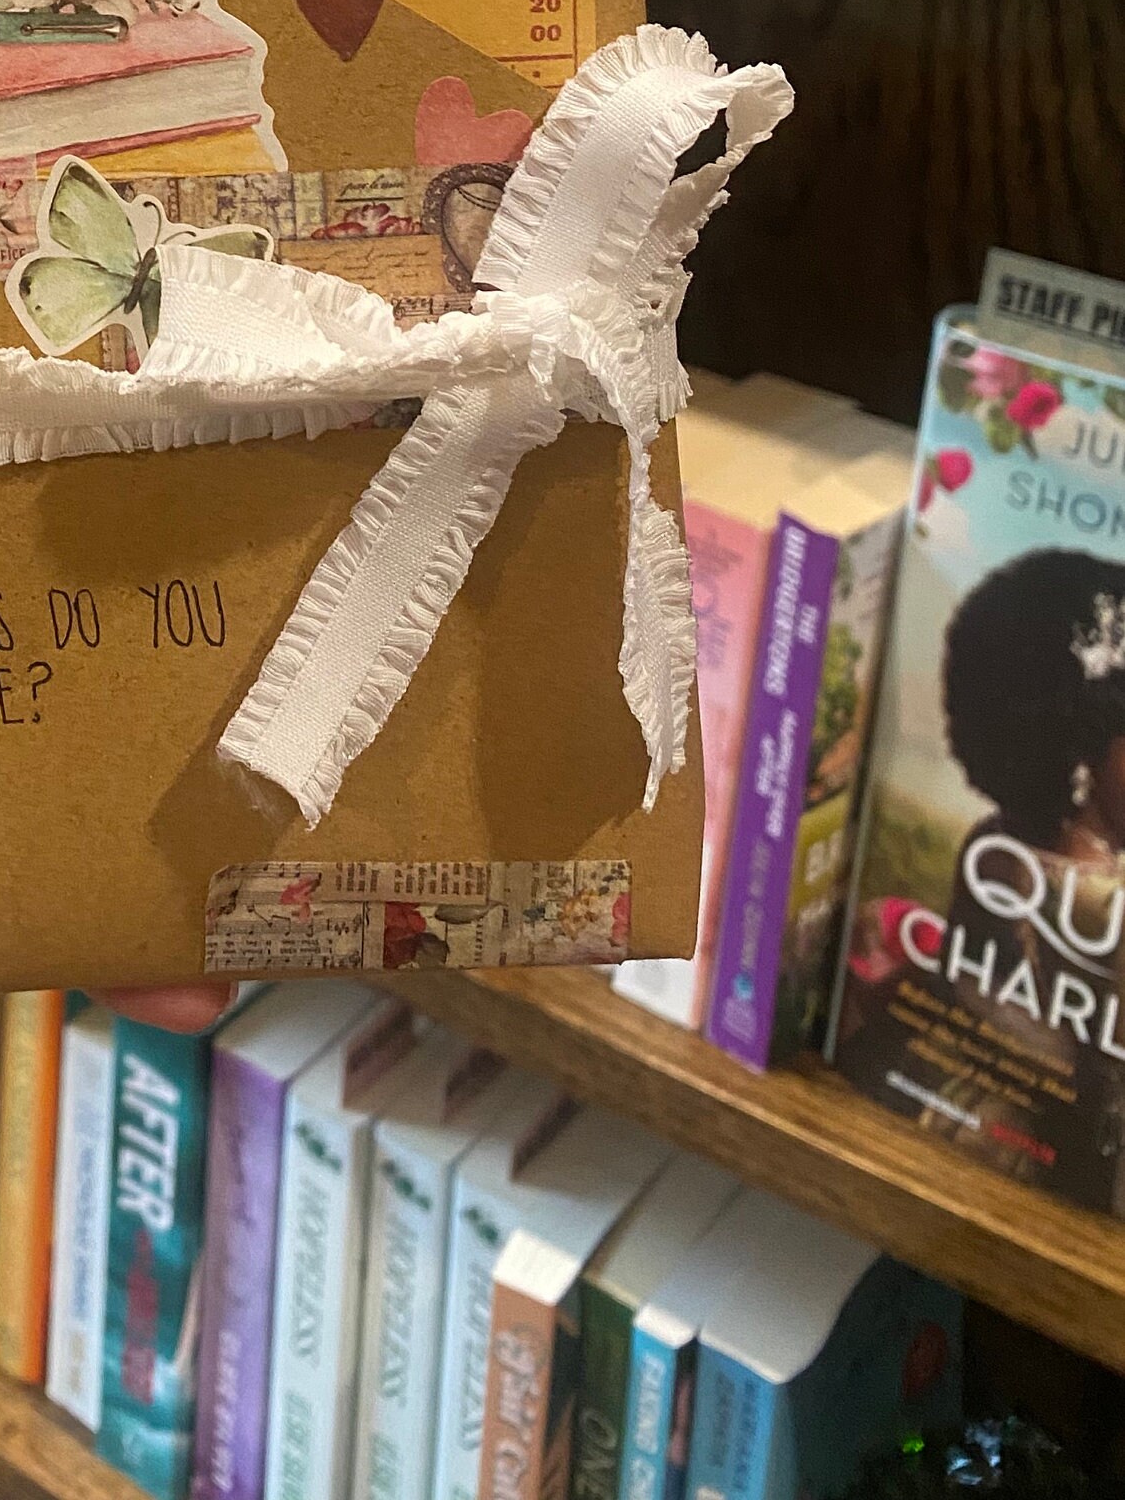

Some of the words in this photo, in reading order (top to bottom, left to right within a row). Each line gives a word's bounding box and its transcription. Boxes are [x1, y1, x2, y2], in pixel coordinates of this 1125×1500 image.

[529, 23, 562, 43] 00
[995, 272, 1087, 327] STAFF
[49, 587, 101, 650] DO
[138, 579, 227, 649] YOU
[962, 832, 1125, 982] QU
[898, 907, 1125, 1063] CHARL
[116, 1052, 181, 1232] AFTER
